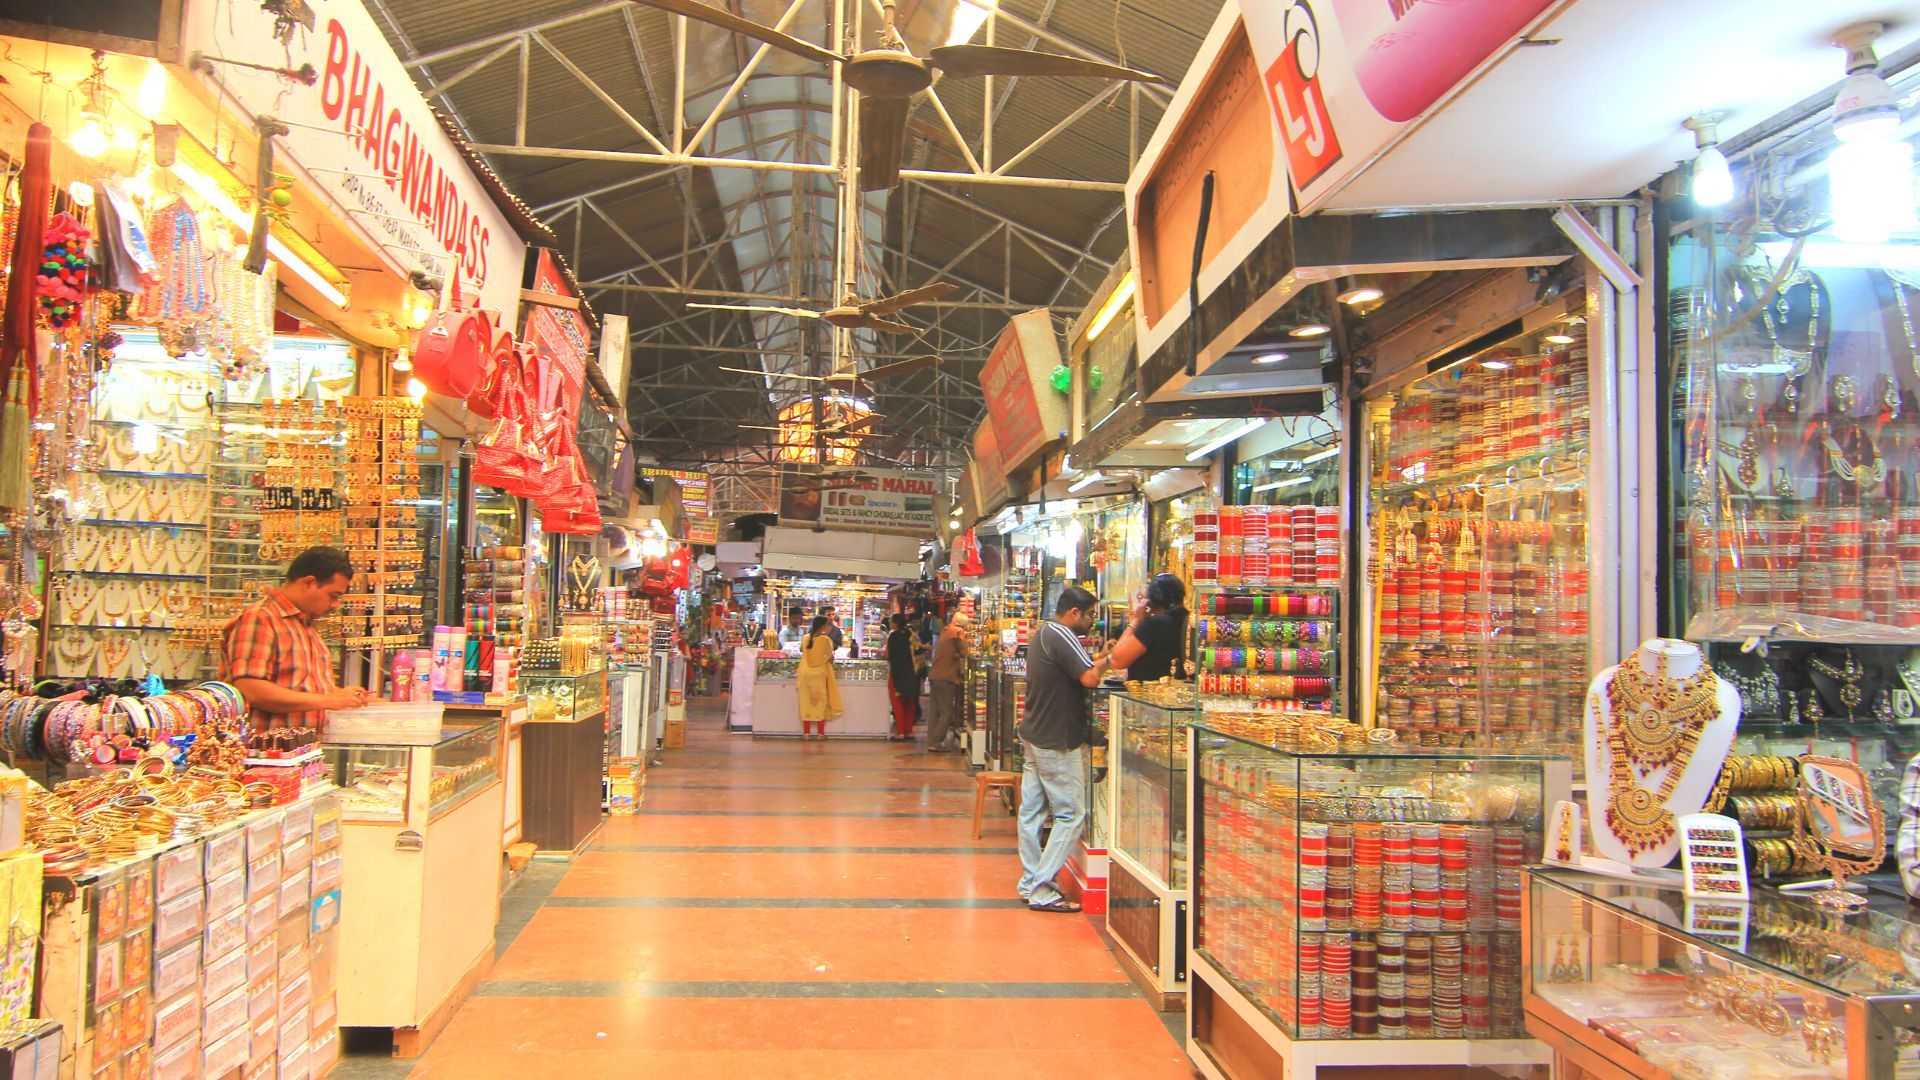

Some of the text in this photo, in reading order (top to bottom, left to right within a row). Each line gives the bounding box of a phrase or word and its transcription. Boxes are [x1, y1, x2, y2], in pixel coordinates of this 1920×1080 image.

[1275, 81, 1325, 158] LJ
[321, 18, 489, 286] BHAGWANDASS
[641, 467, 708, 480] BRIDAL HUT
[881, 477, 937, 495] MAHAL
